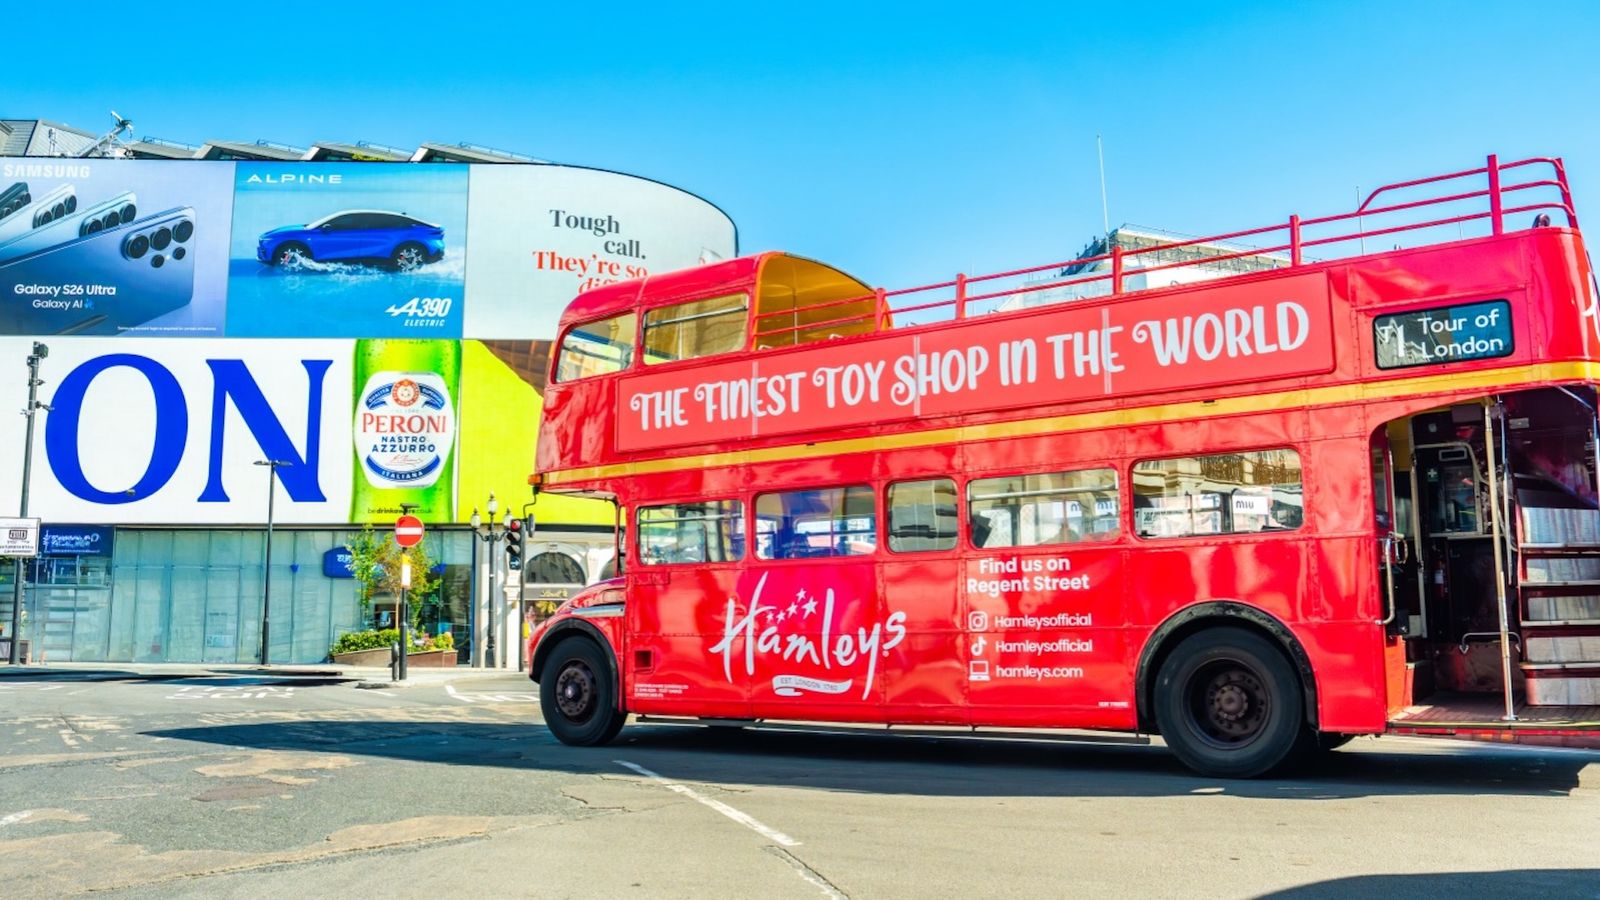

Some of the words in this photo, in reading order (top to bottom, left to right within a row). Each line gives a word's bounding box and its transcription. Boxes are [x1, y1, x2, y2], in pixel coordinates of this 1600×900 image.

[4, 165, 90, 179] SAMSUNG
[247, 174, 342, 184] ALPINE
[549, 209, 620, 237] Tough
[603, 240, 646, 260] call.
[532, 250, 621, 277] They’re
[625, 264, 648, 278] so
[14, 283, 61, 296] Galaxy
[63, 284, 84, 295] S26
[86, 284, 116, 295] Ultra
[32, 299, 70, 310] Galaxy
[72, 299, 83, 309] AI
[385, 297, 451, 317] A390
[404, 318, 446, 327] ELECTRIC
[1418, 316, 1467, 335] Tour
[1475, 308, 1500, 327] of
[1421, 336, 1504, 359] London
[630, 385, 689, 431] THE
[694, 370, 806, 420] FINEST
[812, 360, 888, 409] TOY
[892, 345, 989, 406] SHOP
[998, 336, 1036, 386] IN
[1045, 325, 1125, 378] THE
[1131, 300, 1310, 368] WORLD
[45, 353, 334, 504] ON
[362, 412, 447, 433] PERONI
[371, 444, 436, 453] AZZURRO
[381, 470, 424, 479] ITALIANA
[979, 557, 1016, 573] Find
[1022, 560, 1042, 573] us
[1048, 557, 1070, 571] on
[966, 577, 1029, 597] Regent
[1033, 574, 1090, 591] Street
[995, 613, 1092, 629] Hamleysofficial
[708, 571, 907, 701] Hamleys
[996, 639, 1092, 655] Hamleysofficial
[996, 664, 1082, 680] hamleys.com
